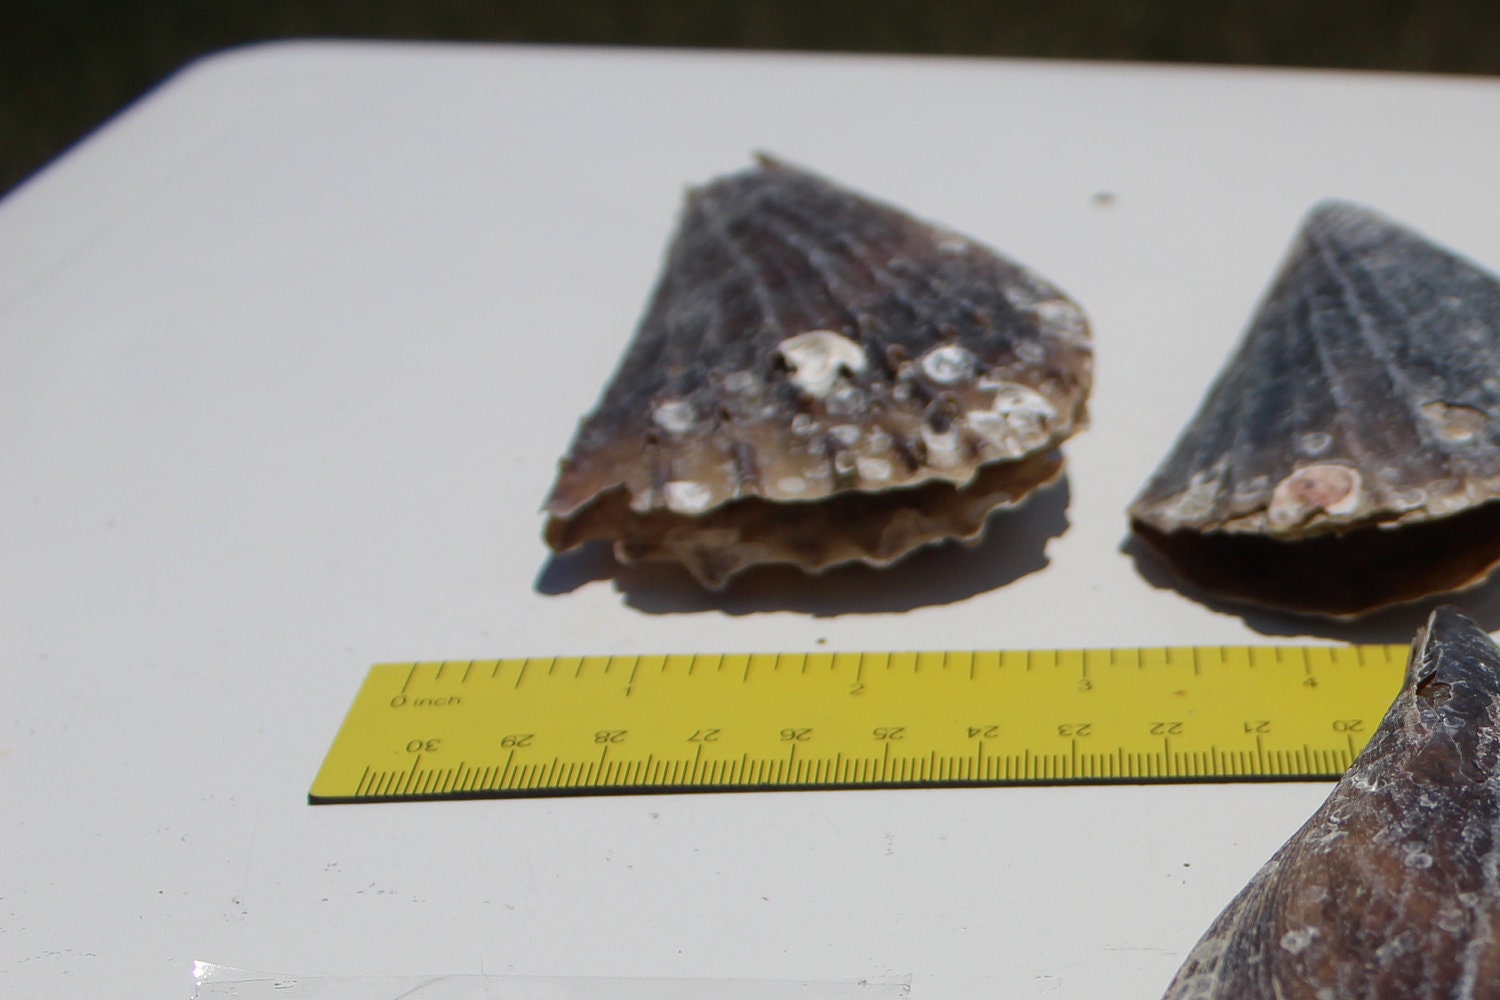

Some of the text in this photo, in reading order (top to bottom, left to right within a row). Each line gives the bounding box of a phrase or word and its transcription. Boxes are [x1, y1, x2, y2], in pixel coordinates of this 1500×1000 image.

[390, 695, 407, 708] 0
[413, 695, 461, 707] inch
[849, 682, 865, 695] 2
[1077, 678, 1093, 692] 3
[1303, 677, 1318, 688] 4
[967, 725, 999, 739] 24
[1057, 723, 1092, 737] 23
[1150, 721, 1183, 735] 22
[1243, 720, 1270, 734] 21
[1332, 719, 1363, 732] 20
[594, 729, 628, 744] 28
[687, 728, 721, 742] 27
[780, 728, 813, 742] 26
[873, 726, 905, 740] 25
[405, 738, 442, 752] 30
[500, 733, 535, 748] 29
